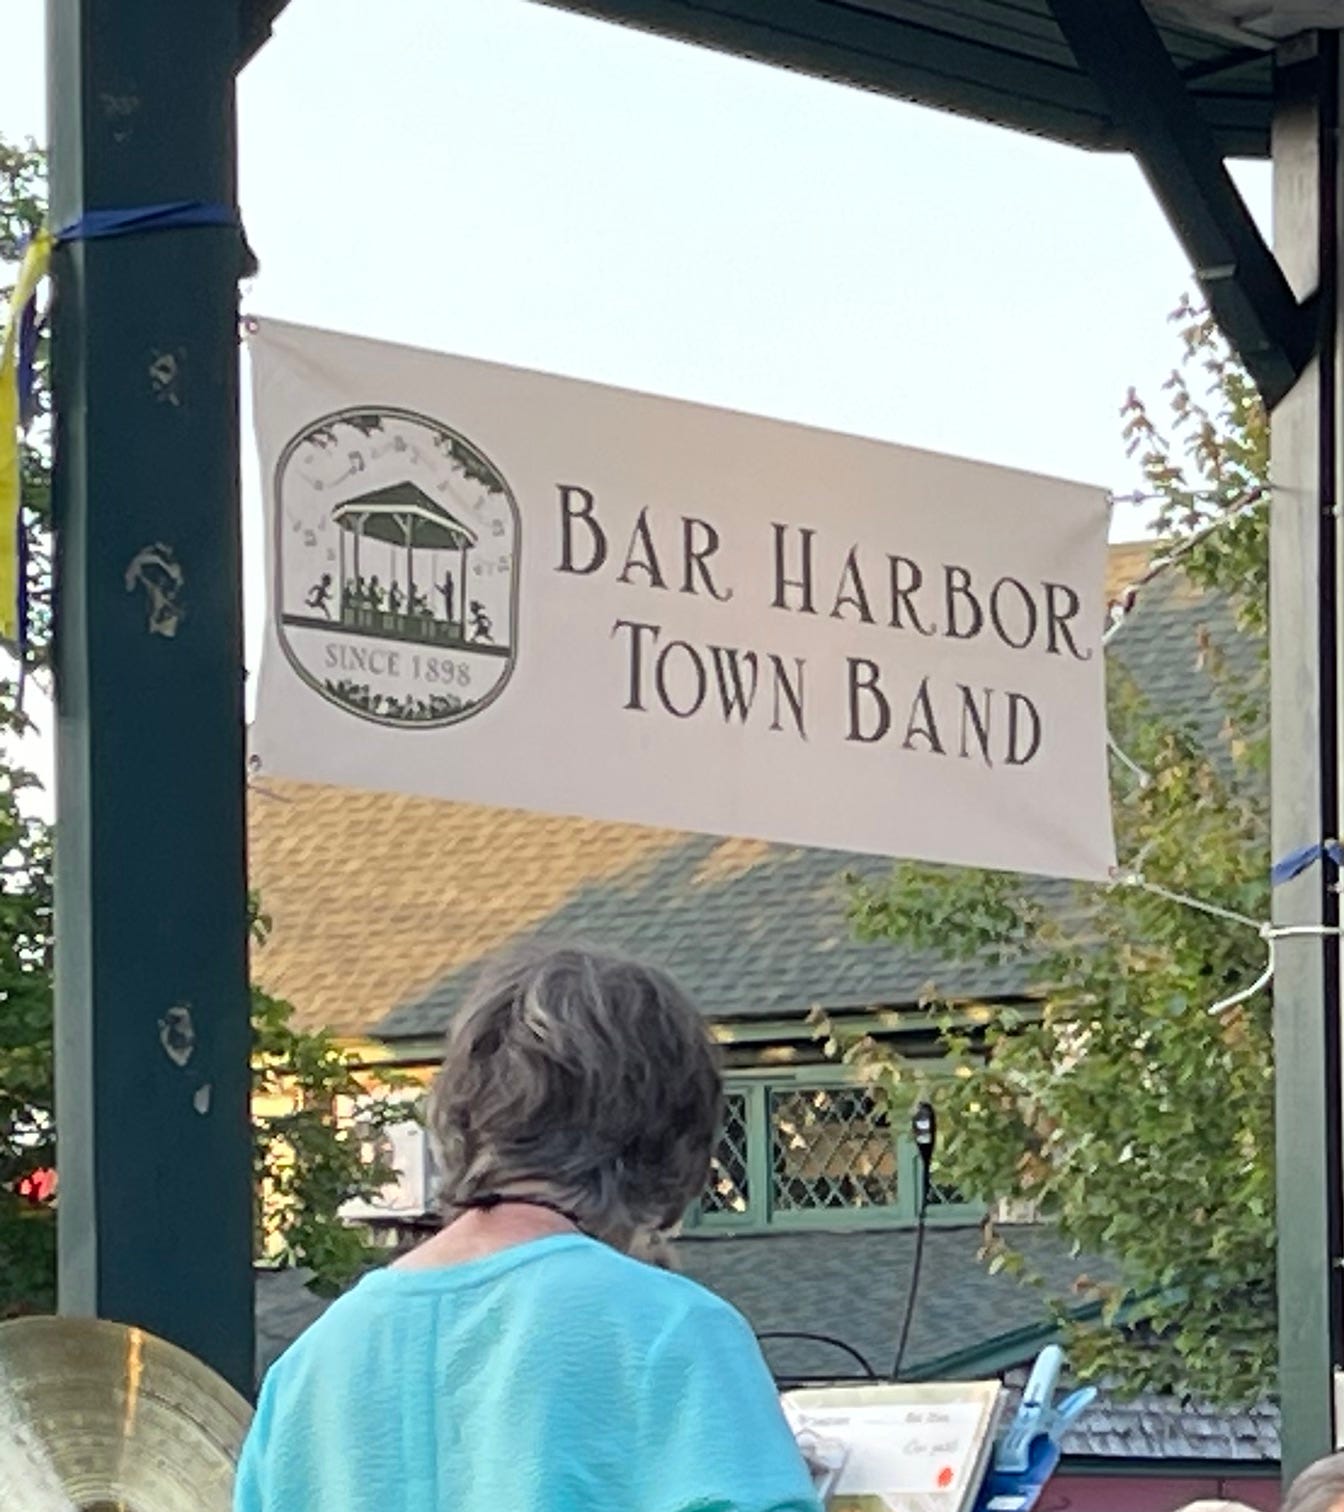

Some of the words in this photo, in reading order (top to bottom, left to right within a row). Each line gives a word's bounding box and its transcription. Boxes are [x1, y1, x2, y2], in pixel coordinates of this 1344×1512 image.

[553, 483, 734, 602] BAR
[769, 521, 1094, 661] HARBOR
[324, 642, 401, 677] SINCE
[411, 654, 472, 688] 1898
[610, 617, 808, 742] TOWN
[844, 655, 1042, 770] BAND
